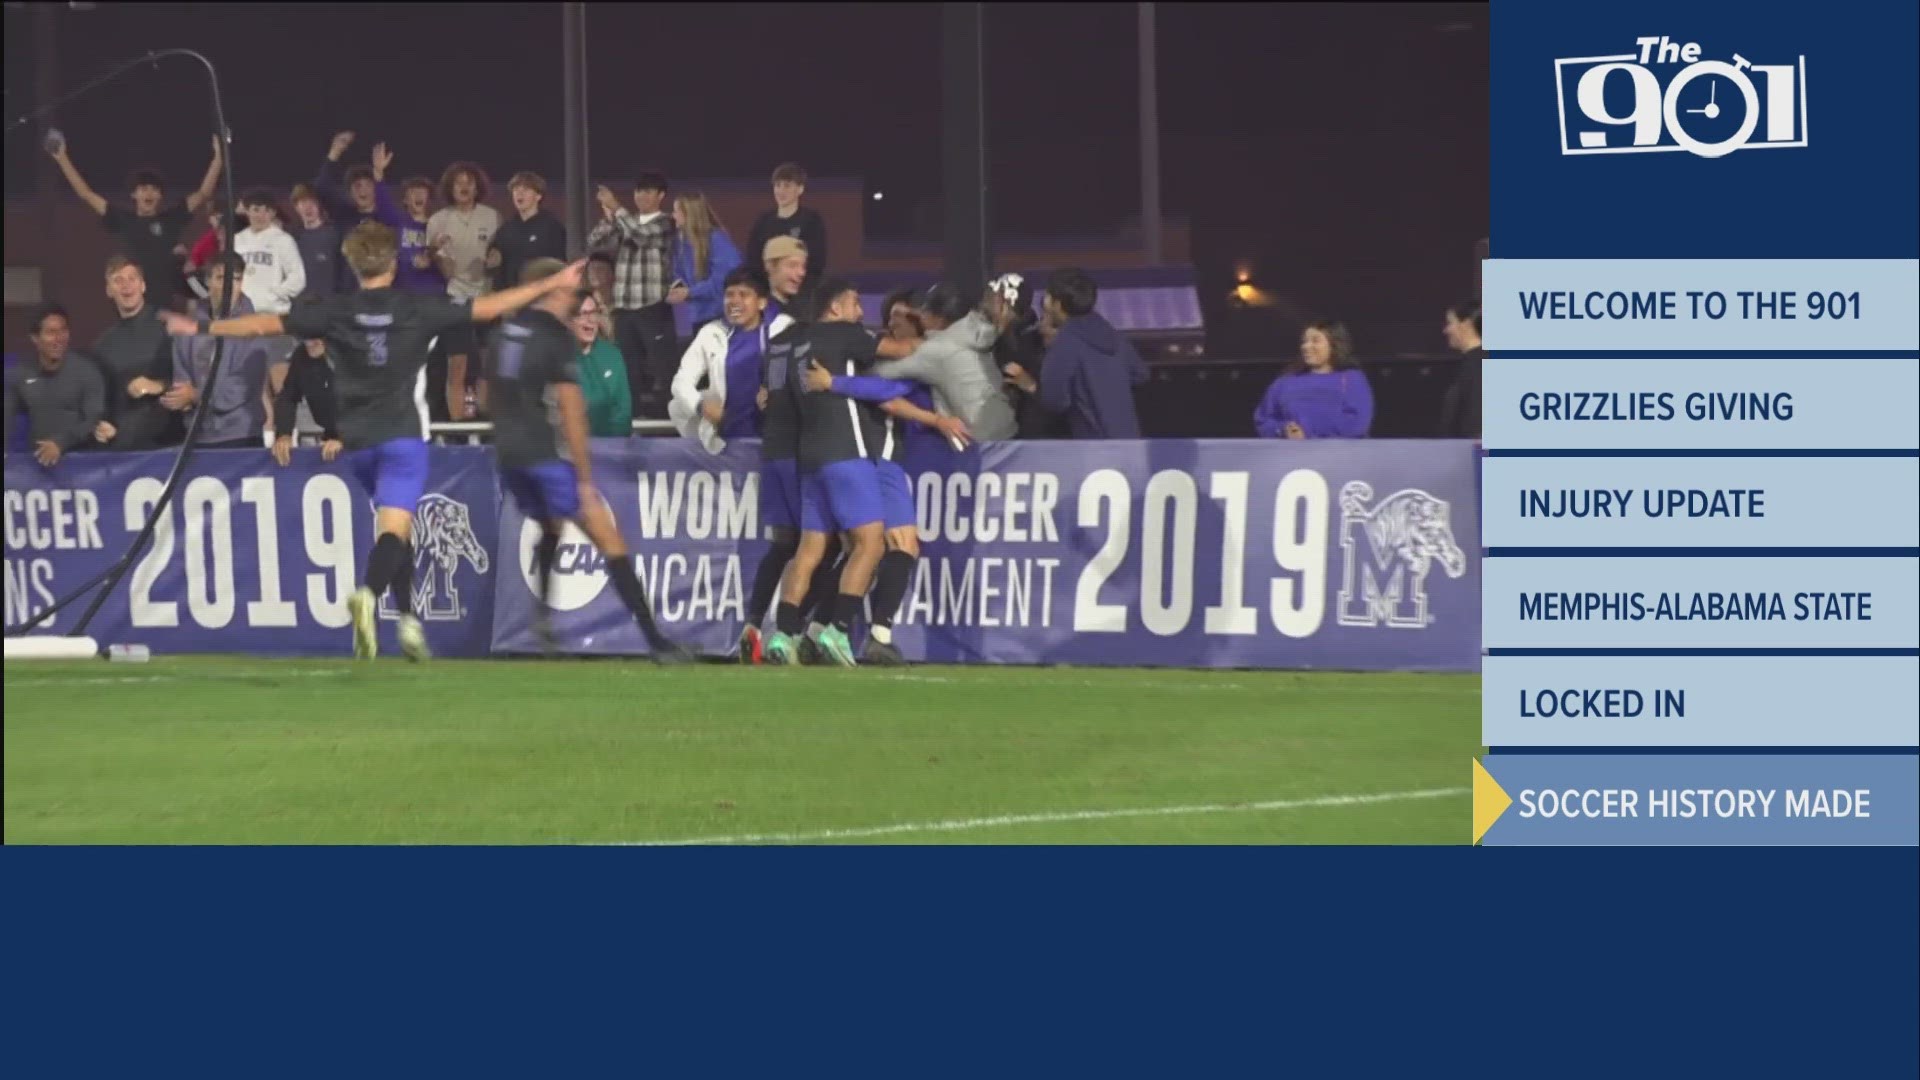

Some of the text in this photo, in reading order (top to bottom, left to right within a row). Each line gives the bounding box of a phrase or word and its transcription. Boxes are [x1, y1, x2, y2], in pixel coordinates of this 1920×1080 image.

[124, 473, 357, 629] 2019
[906, 471, 1060, 543] OCCER
[1074, 469, 1329, 638] 2019
[893, 557, 1060, 628] AMENT
